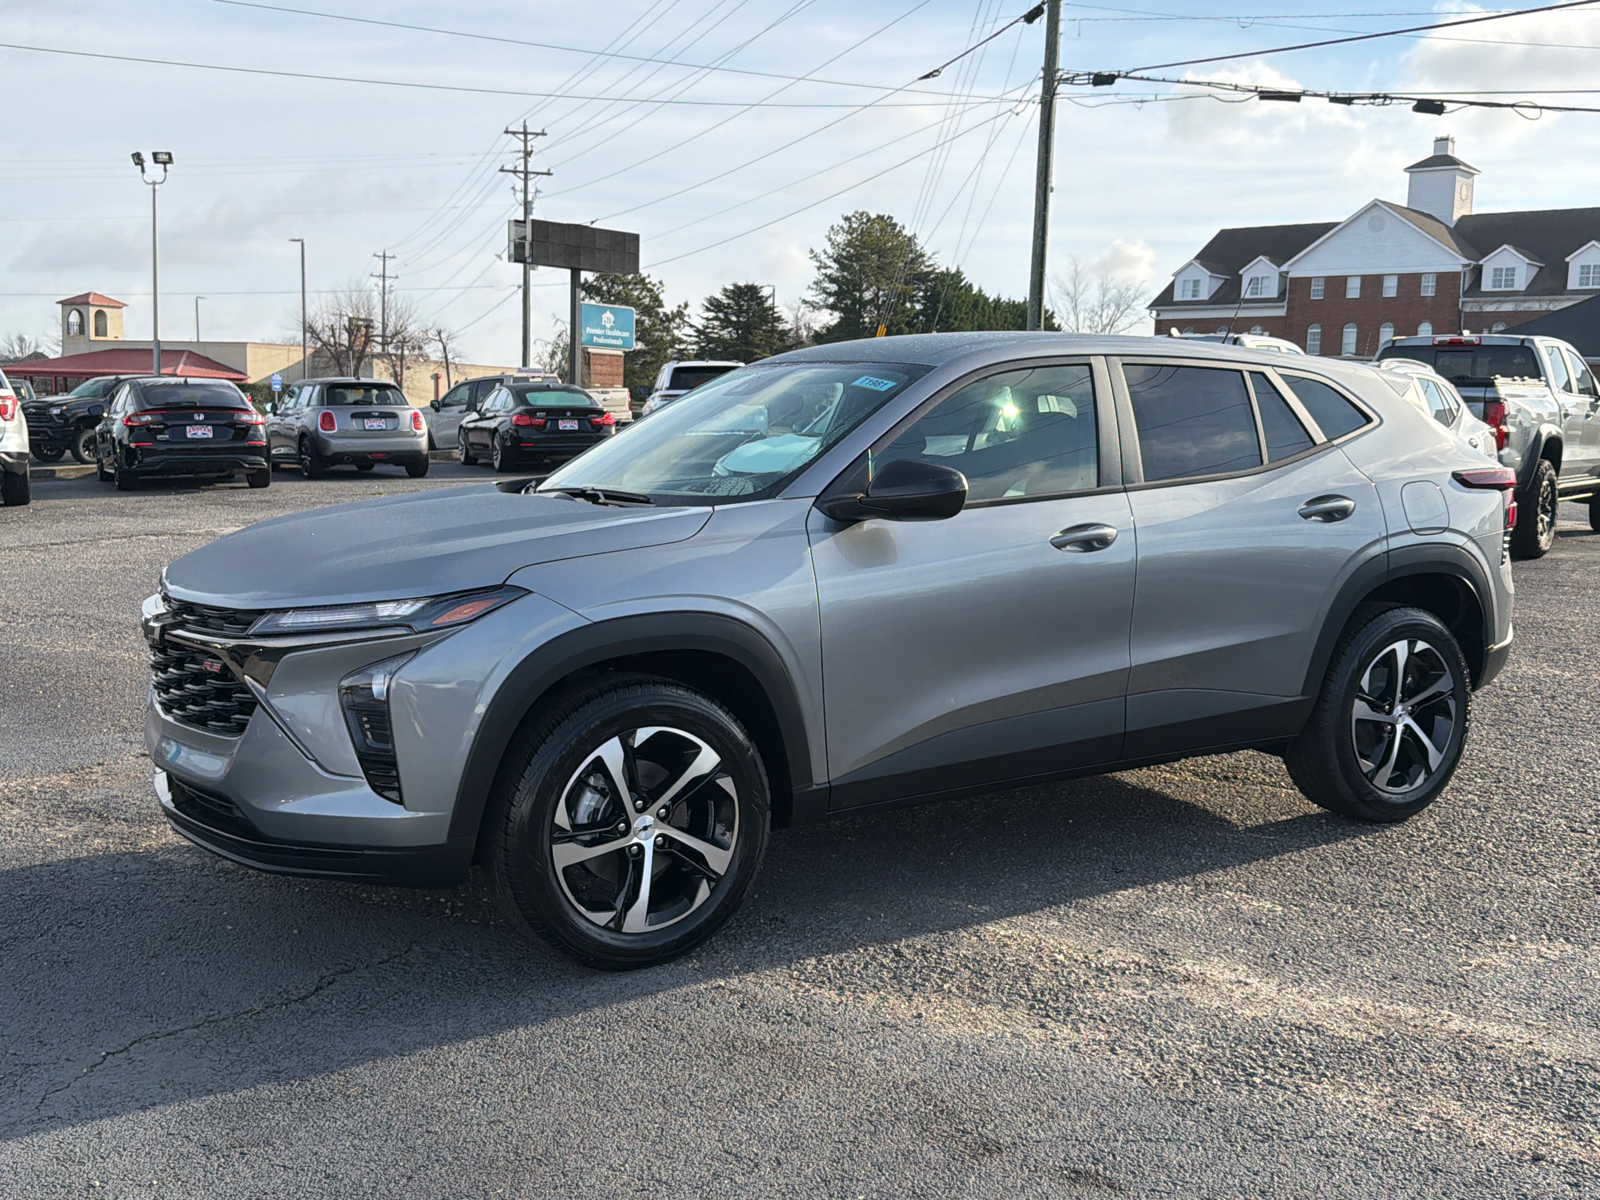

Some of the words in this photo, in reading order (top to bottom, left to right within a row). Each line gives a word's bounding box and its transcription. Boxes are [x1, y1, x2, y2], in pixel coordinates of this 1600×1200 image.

[585, 326, 605, 335] Premier
[605, 328, 630, 338] Healthcare
[593, 336, 623, 345] Professionals
[202, 661, 221, 673] RS
